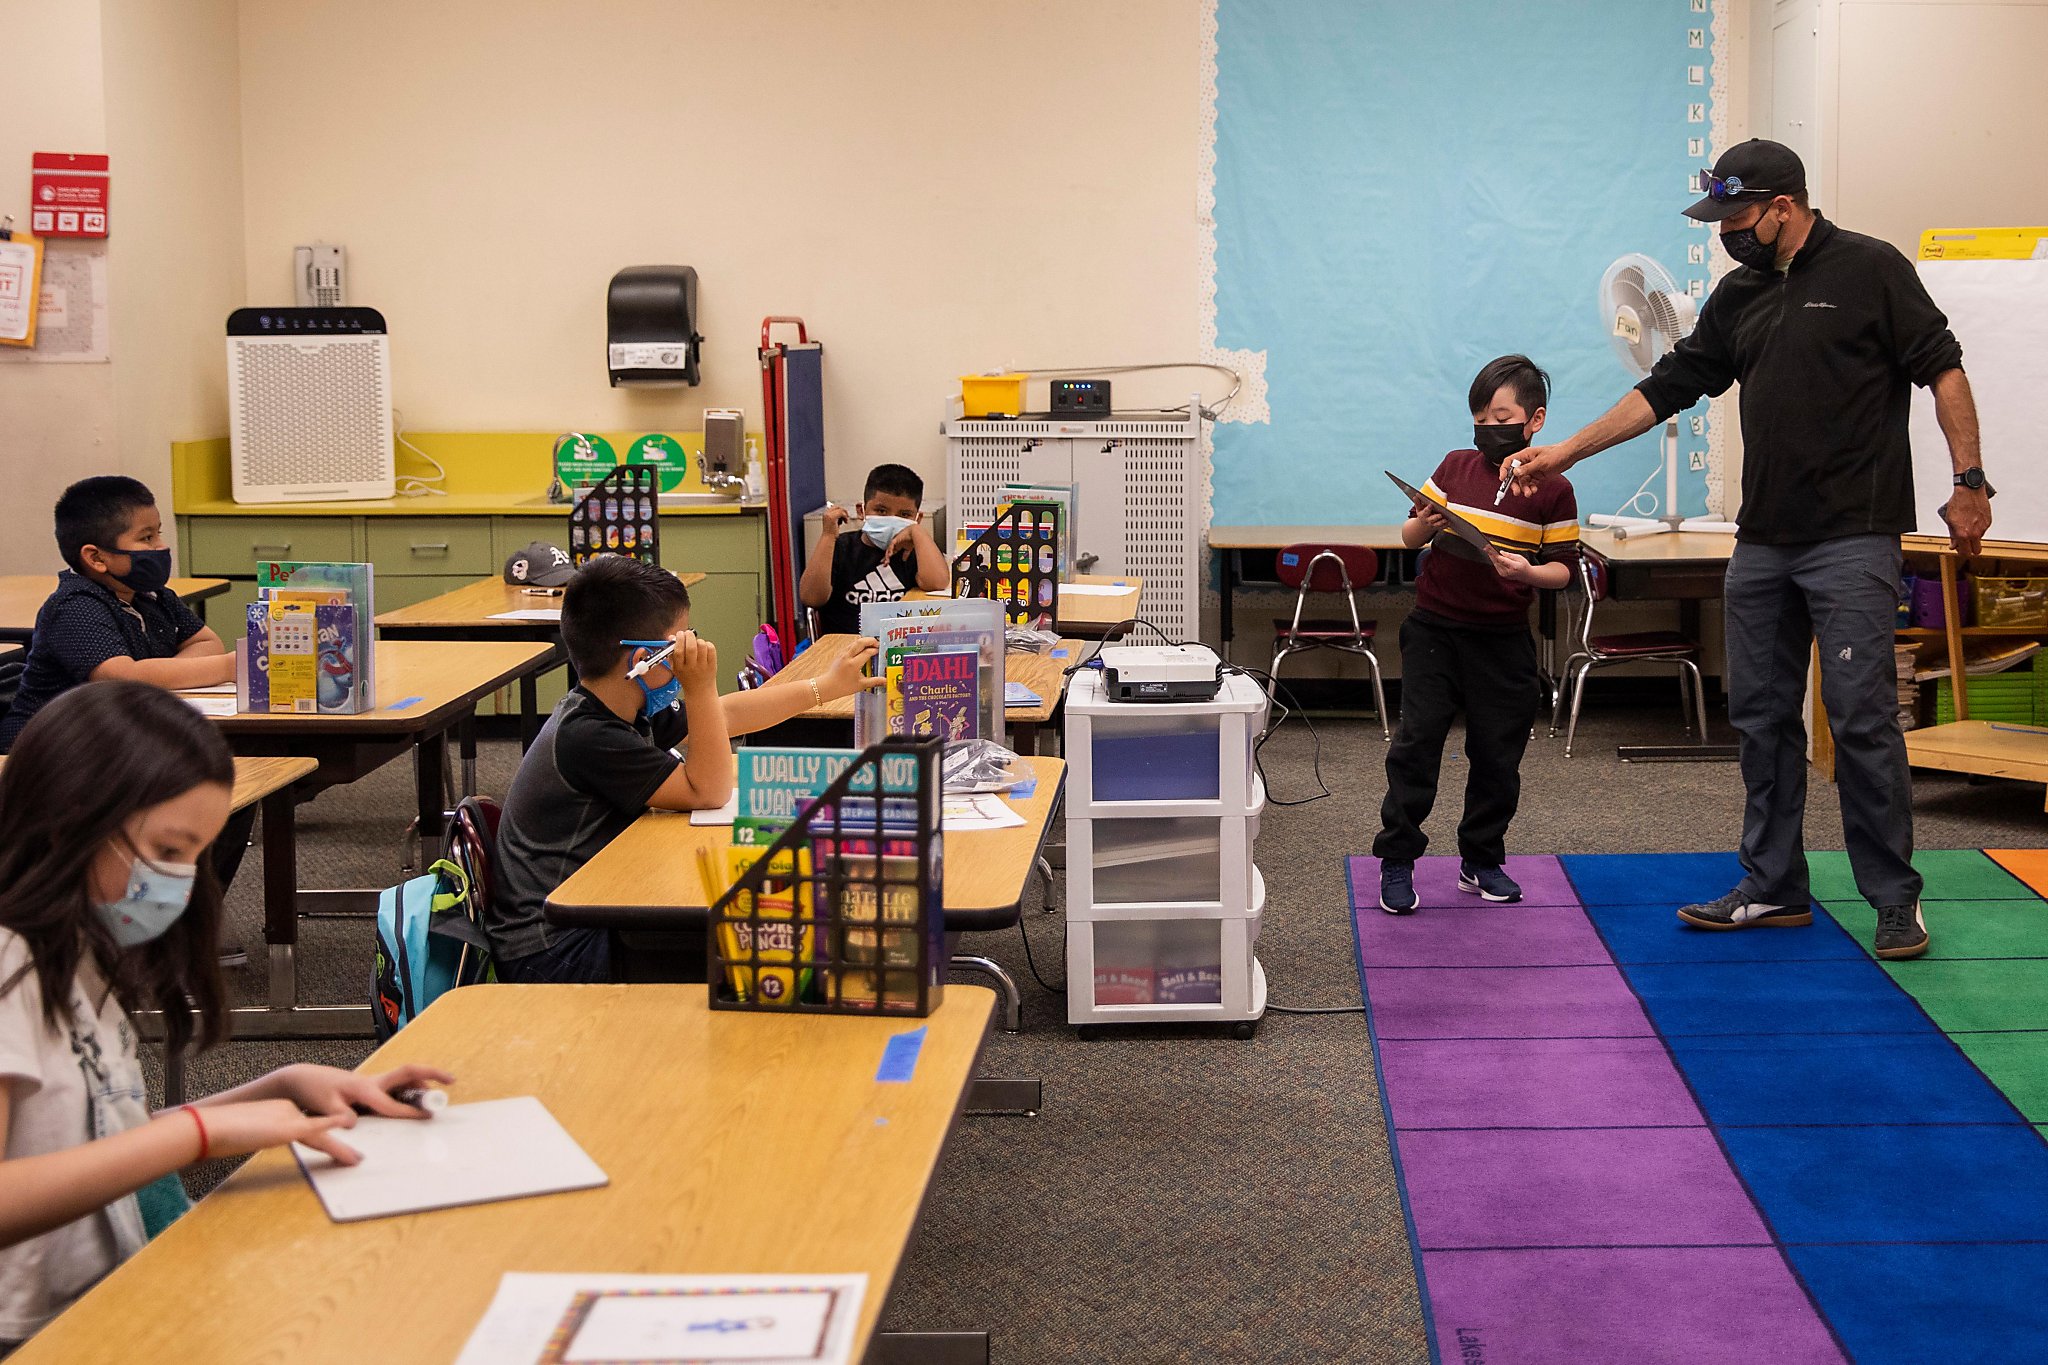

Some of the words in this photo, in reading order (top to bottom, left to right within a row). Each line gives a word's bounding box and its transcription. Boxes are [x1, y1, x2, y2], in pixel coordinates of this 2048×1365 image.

[1690, 31, 1702, 45] M
[1690, 67, 1701, 83] L
[1692, 105, 1701, 120] K
[1691, 139, 1701, 154] J
[1691, 244, 1700, 264] G
[1691, 280, 1700, 297] F
[1617, 316, 1638, 336] Fan
[1692, 416, 1701, 431] B
[1691, 452, 1702, 468] A
[845, 590, 905, 605] adida
[892, 655, 902, 665] 12
[912, 655, 975, 683] DAHL
[920, 684, 957, 695] Charlie
[753, 755, 820, 784] WALLY
[881, 758, 916, 786] NOT
[750, 788, 812, 816] WAN
[842, 808, 863, 819] STEP
[884, 809, 918, 821] EADING
[738, 827, 755, 843] 12
[740, 932, 803, 952] PNCIL
[763, 979, 780, 994] 12
